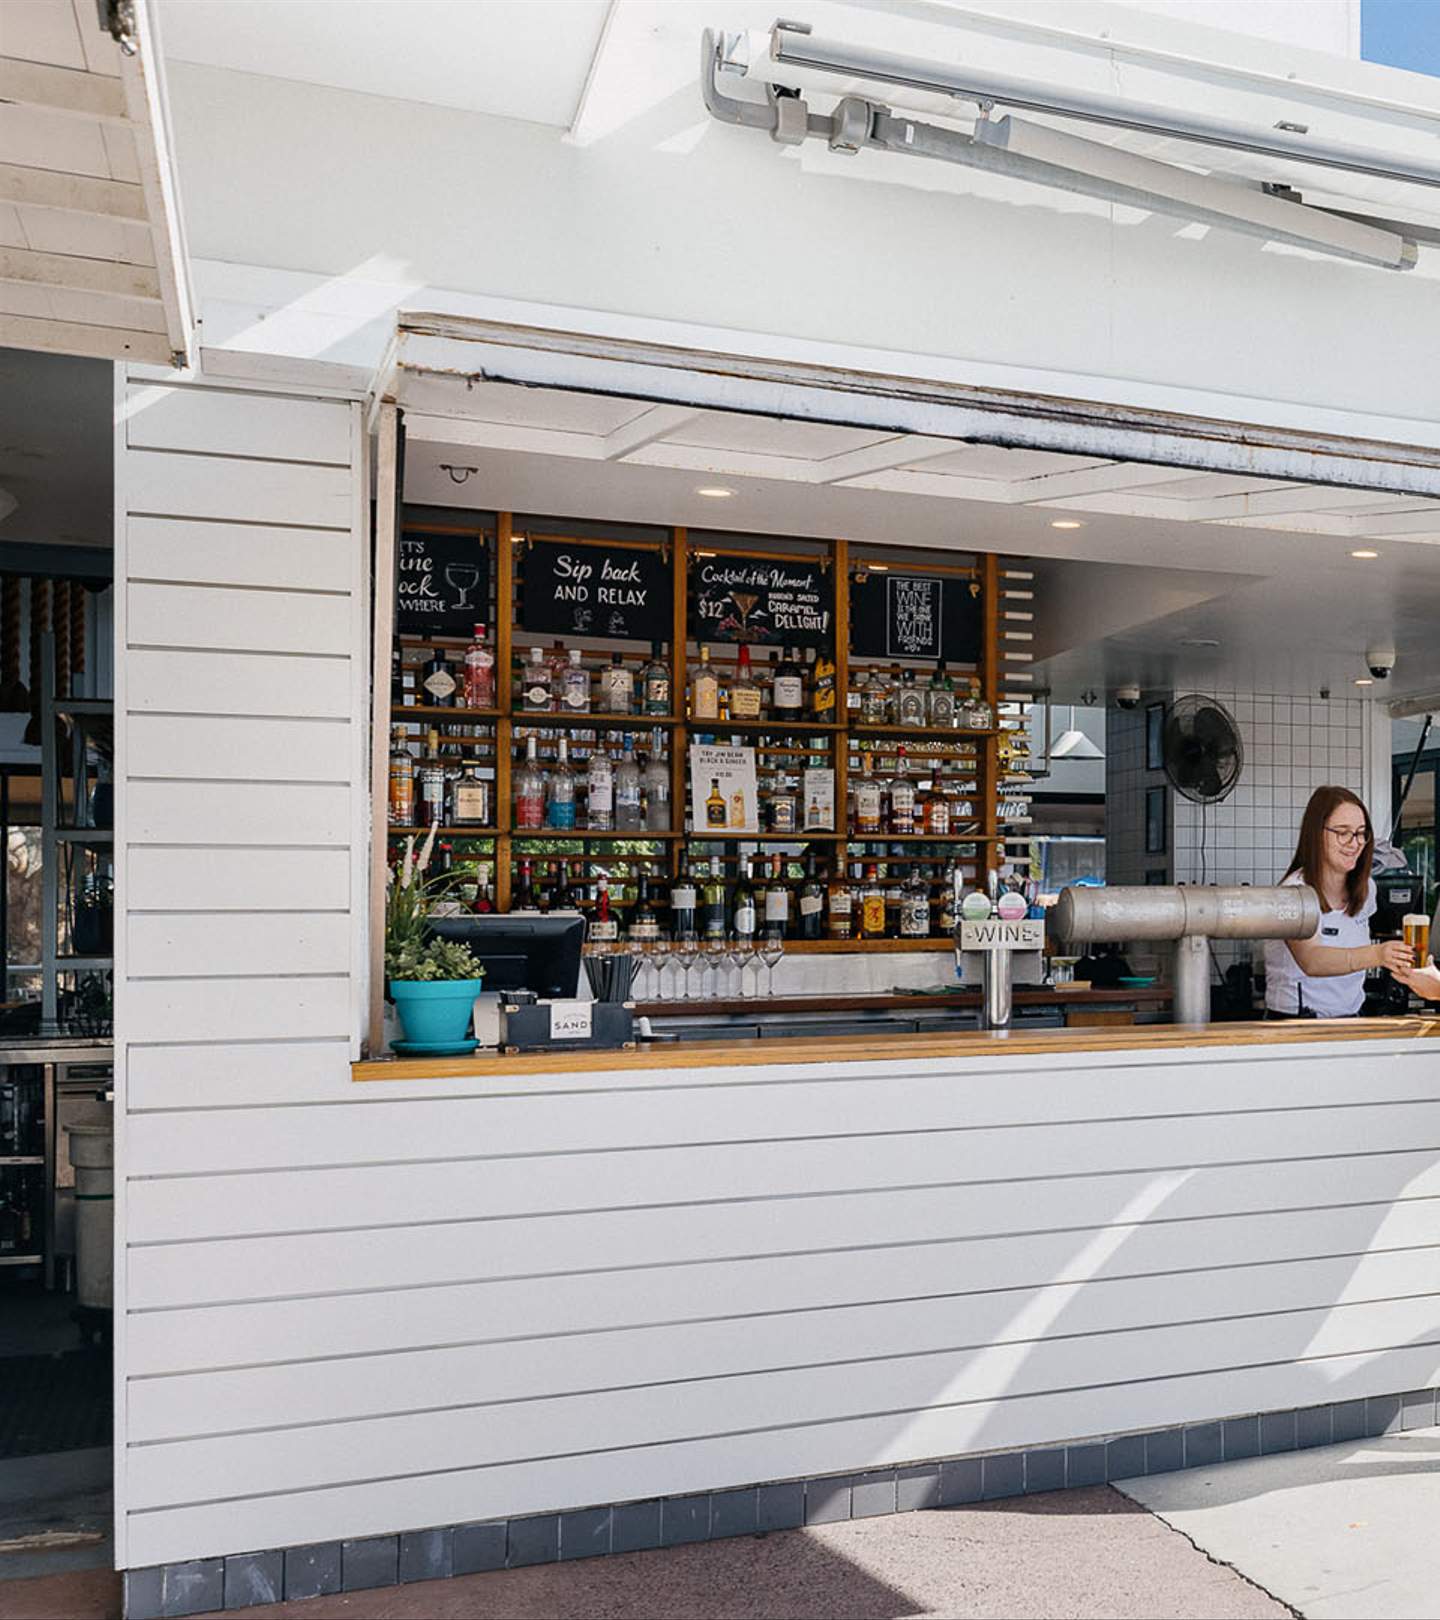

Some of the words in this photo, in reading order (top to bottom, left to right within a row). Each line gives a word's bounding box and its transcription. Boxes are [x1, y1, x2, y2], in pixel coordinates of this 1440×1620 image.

[399, 553, 433, 572] ine
[553, 554, 592, 583] Sip
[600, 558, 641, 583] back
[701, 565, 747, 585] Cocktail
[745, 571, 757, 586] of
[757, 571, 769, 586] the
[769, 569, 813, 589] Moment
[553, 585, 589, 602] AND
[597, 586, 647, 606] RELAX
[896, 590, 932, 606] WINE
[397, 599, 446, 613] WHERE
[699, 598, 723, 618] $12
[768, 600, 819, 615] CARAMEL
[774, 611, 830, 634] DELIGHT!
[896, 620, 933, 638] WITH
[974, 925, 1033, 942] WINE
